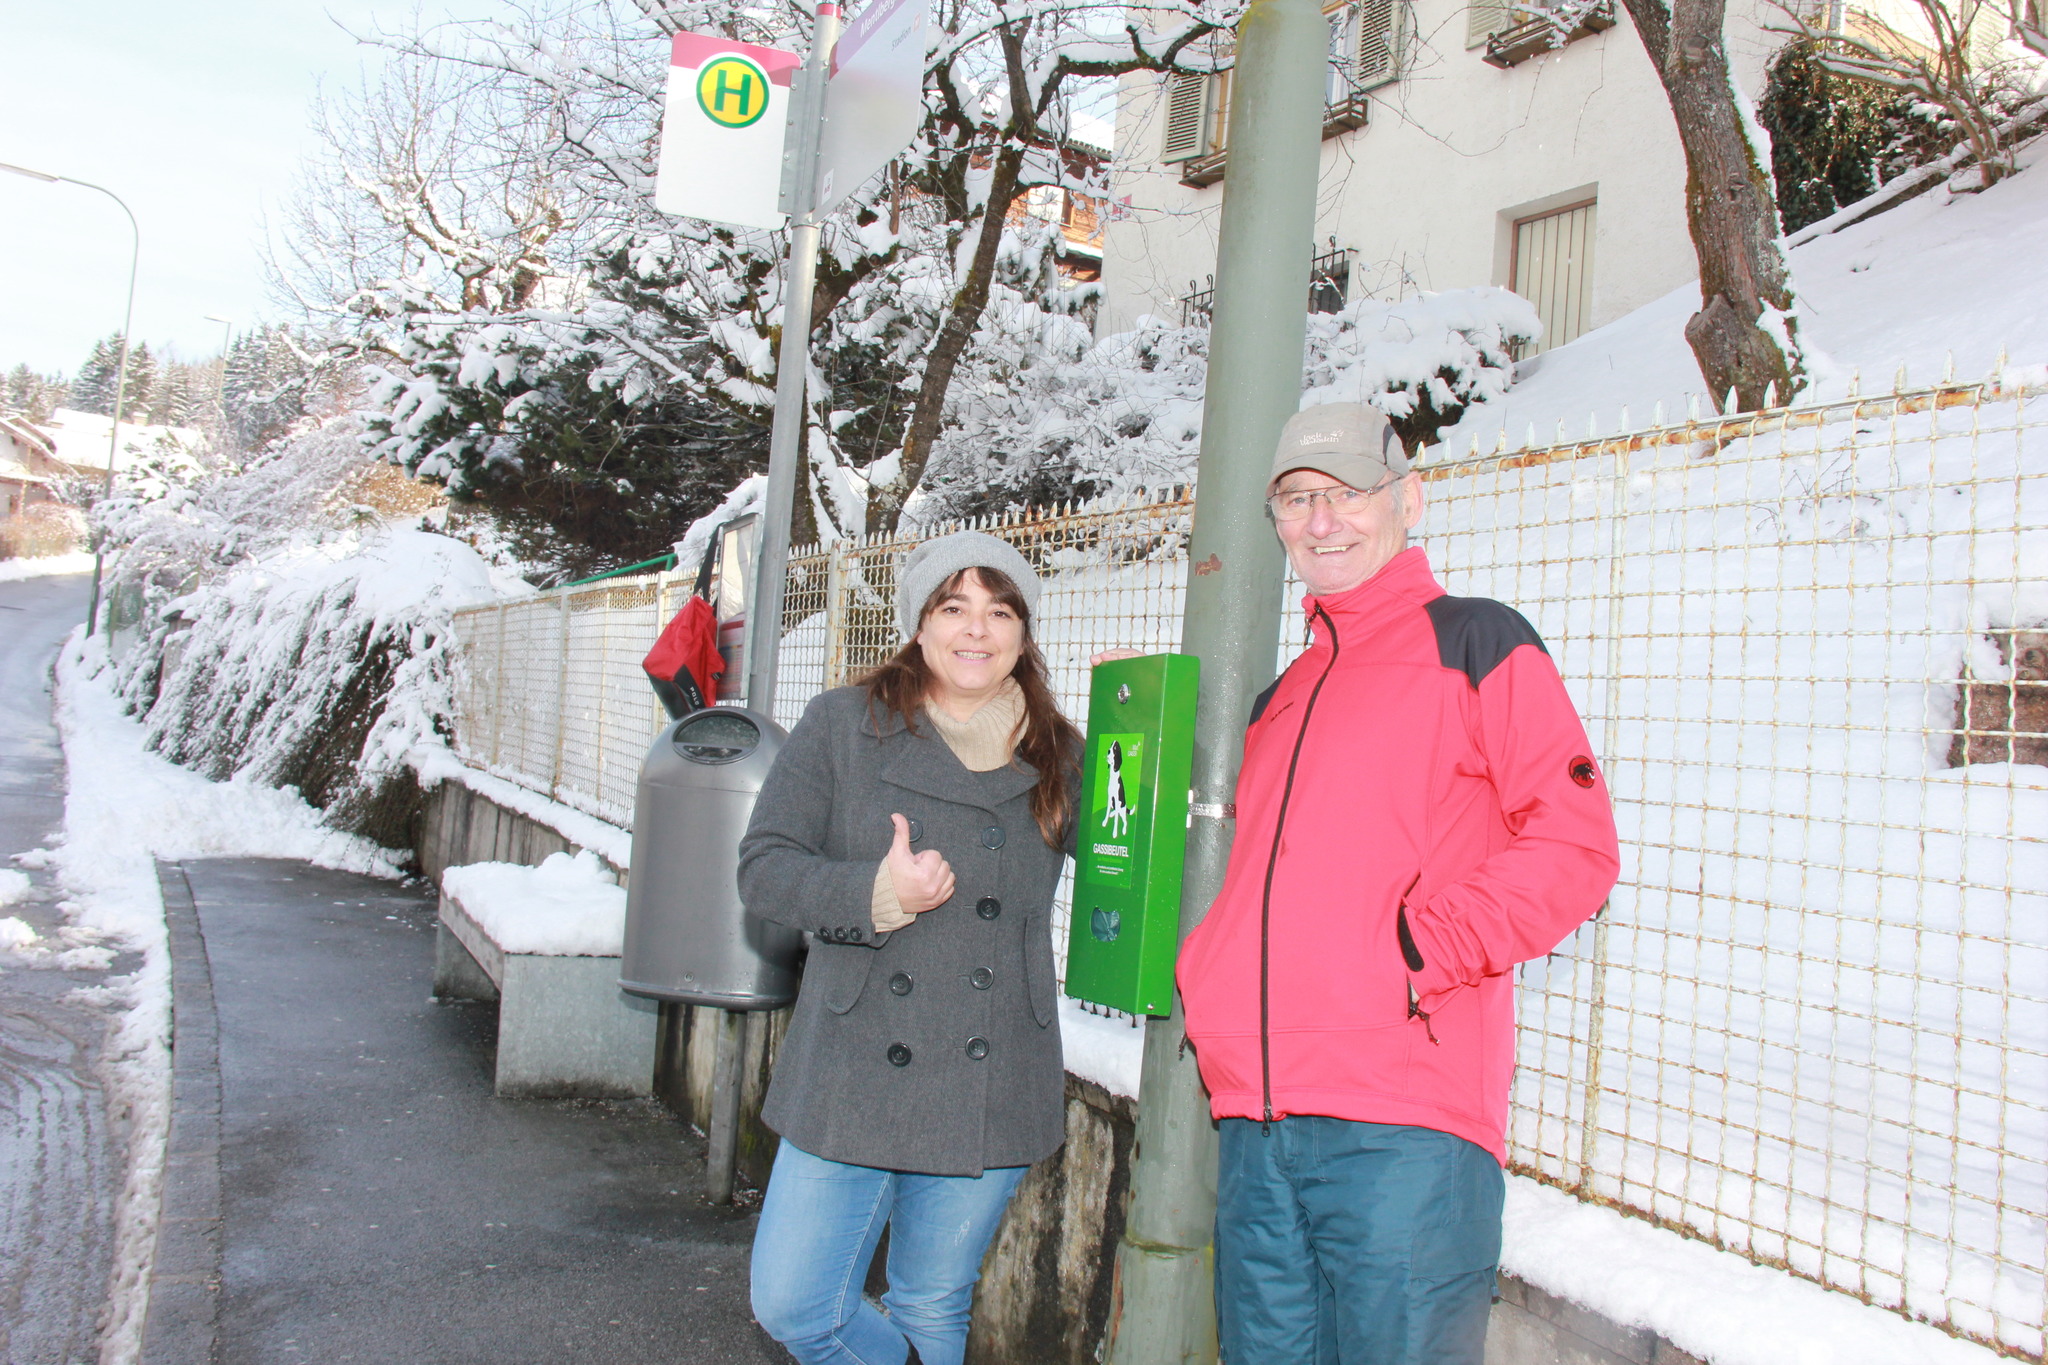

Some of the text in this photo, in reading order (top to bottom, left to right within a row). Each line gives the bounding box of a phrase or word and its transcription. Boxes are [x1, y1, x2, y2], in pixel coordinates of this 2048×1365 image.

[714, 69, 751, 116] H
[689, 686, 700, 706] POLO
[1093, 842, 1129, 858] GASSIBEUTEL
